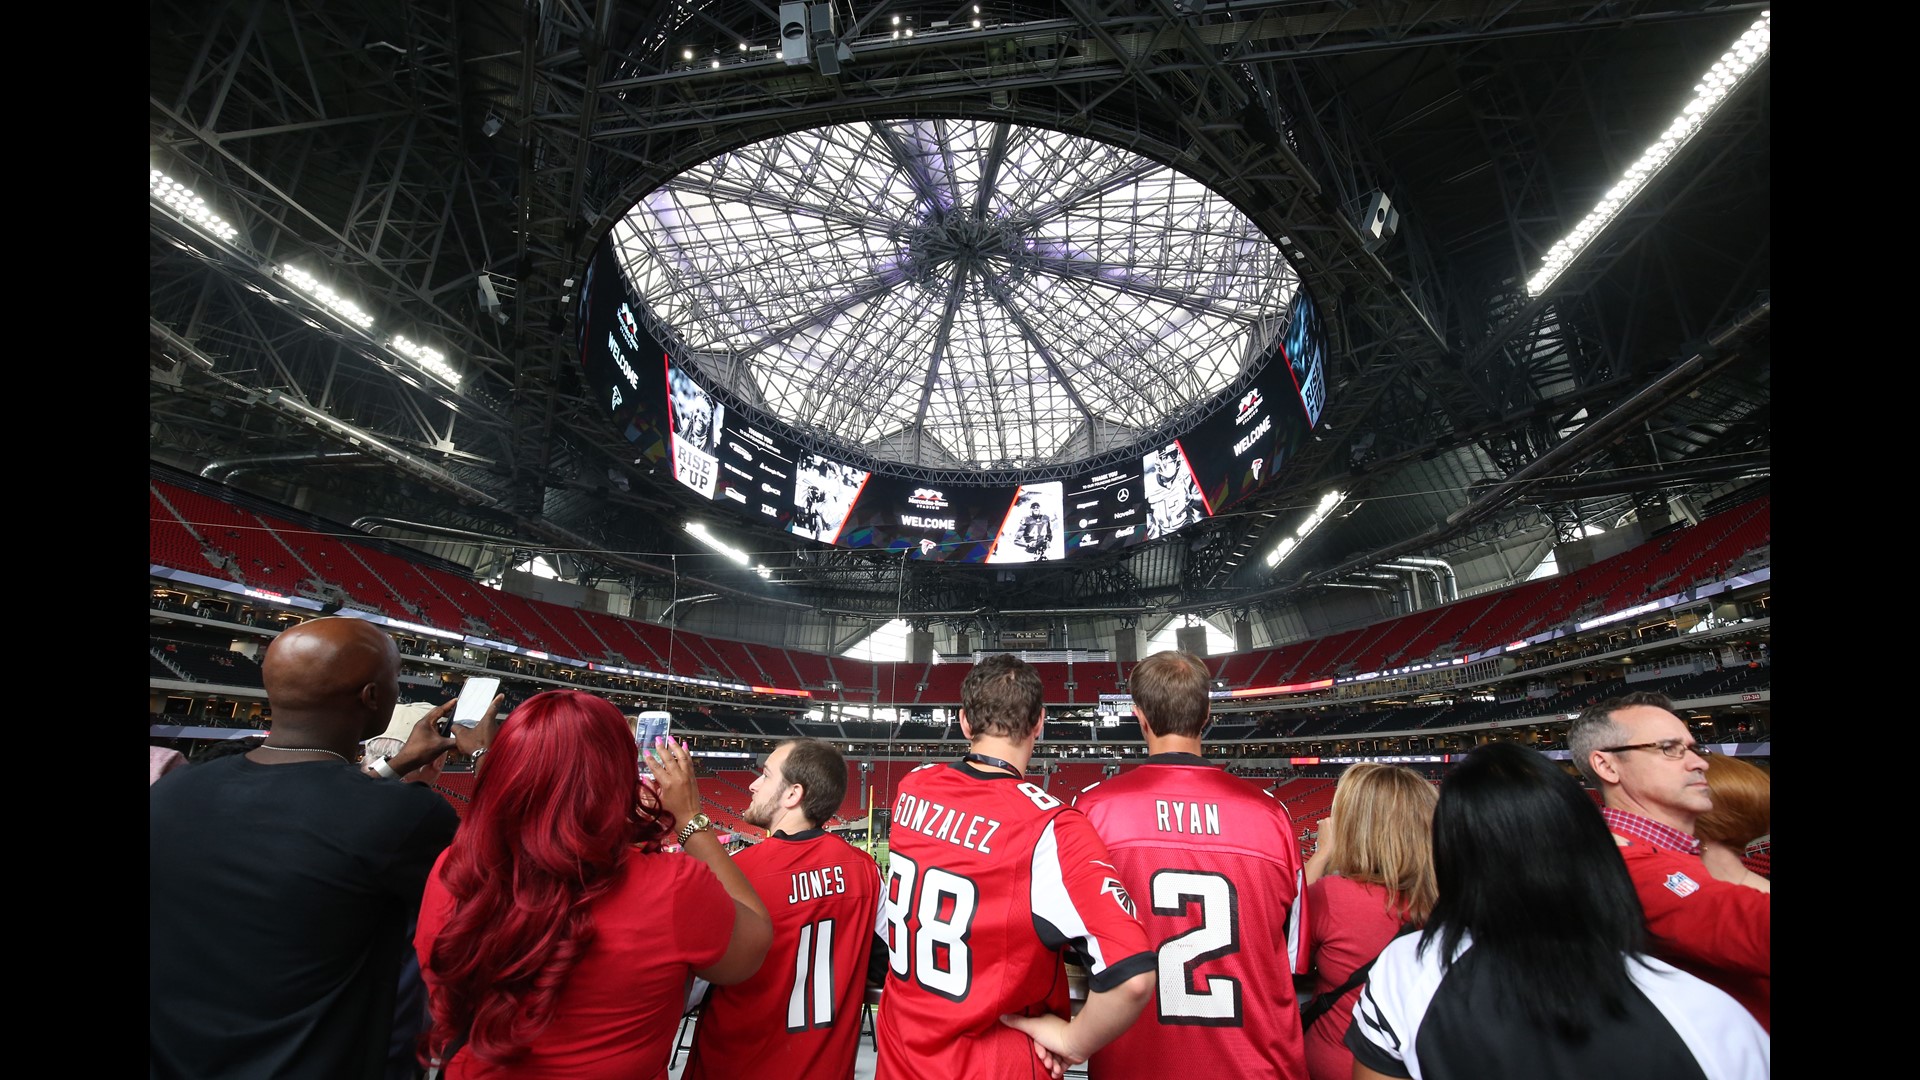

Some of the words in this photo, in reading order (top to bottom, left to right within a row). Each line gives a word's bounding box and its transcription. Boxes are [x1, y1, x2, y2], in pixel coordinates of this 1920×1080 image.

[608, 330, 639, 391] WELCOME
[1233, 414, 1272, 458] WELCOME
[678, 444, 711, 476] RISE
[689, 469, 709, 490] UP
[1091, 474, 1108, 483] THANK
[901, 515, 956, 530] WELCOME
[893, 791, 1001, 855] GONZALEZ
[1155, 799, 1221, 836] RYAN
[788, 865, 846, 905] JONES
[887, 849, 980, 1003] 88
[1149, 867, 1244, 1029] 2
[785, 918, 836, 1034] 11
